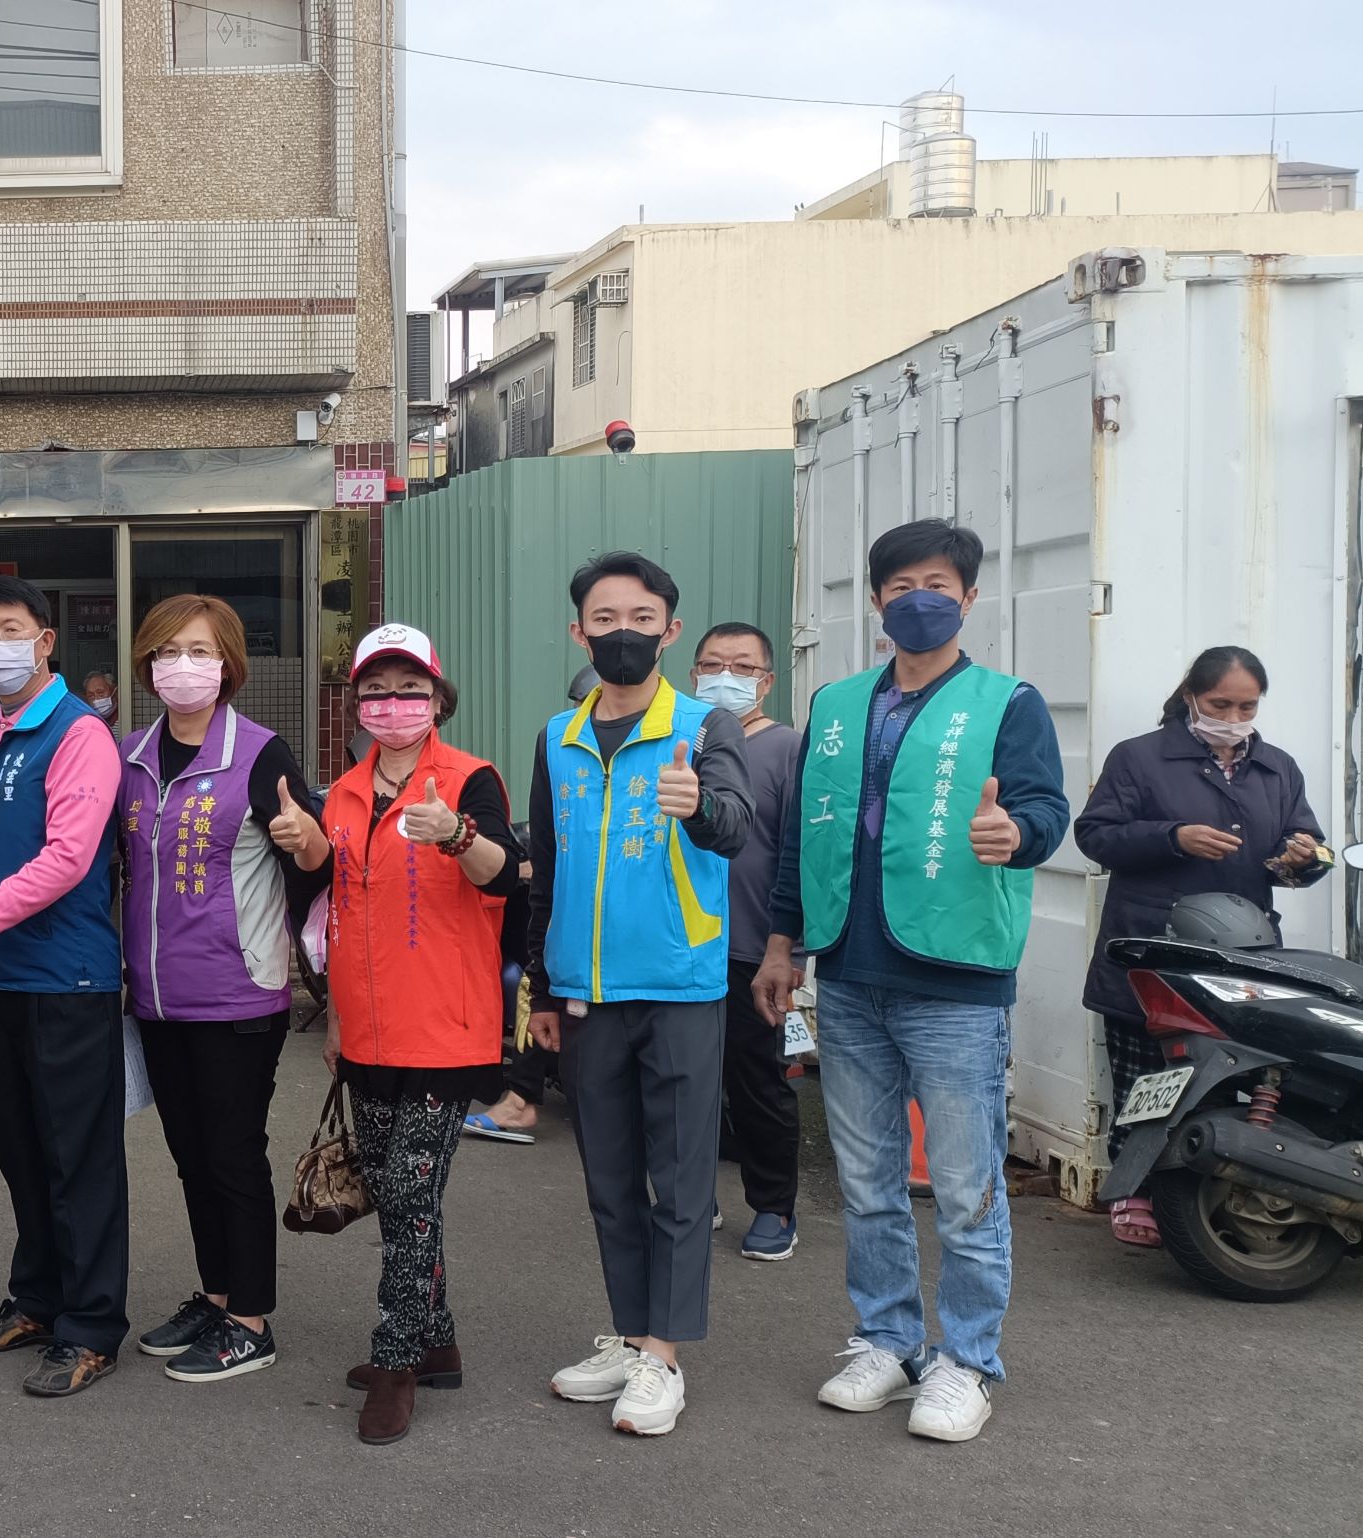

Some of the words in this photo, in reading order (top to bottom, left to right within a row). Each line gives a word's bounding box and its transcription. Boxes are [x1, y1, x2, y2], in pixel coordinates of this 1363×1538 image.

[350, 483, 375, 500] 42
[336, 560, 353, 676] 凌辦公處
[809, 719, 844, 825] 志工
[923, 712, 971, 880] 隆祥經濟發展基金會
[175, 795, 197, 894] 感恩服務團隊
[192, 795, 216, 856] 黃敬平
[621, 774, 649, 860] 徐玉樹
[192, 862, 206, 895] 議員
[219, 1340, 257, 1368] FILA
